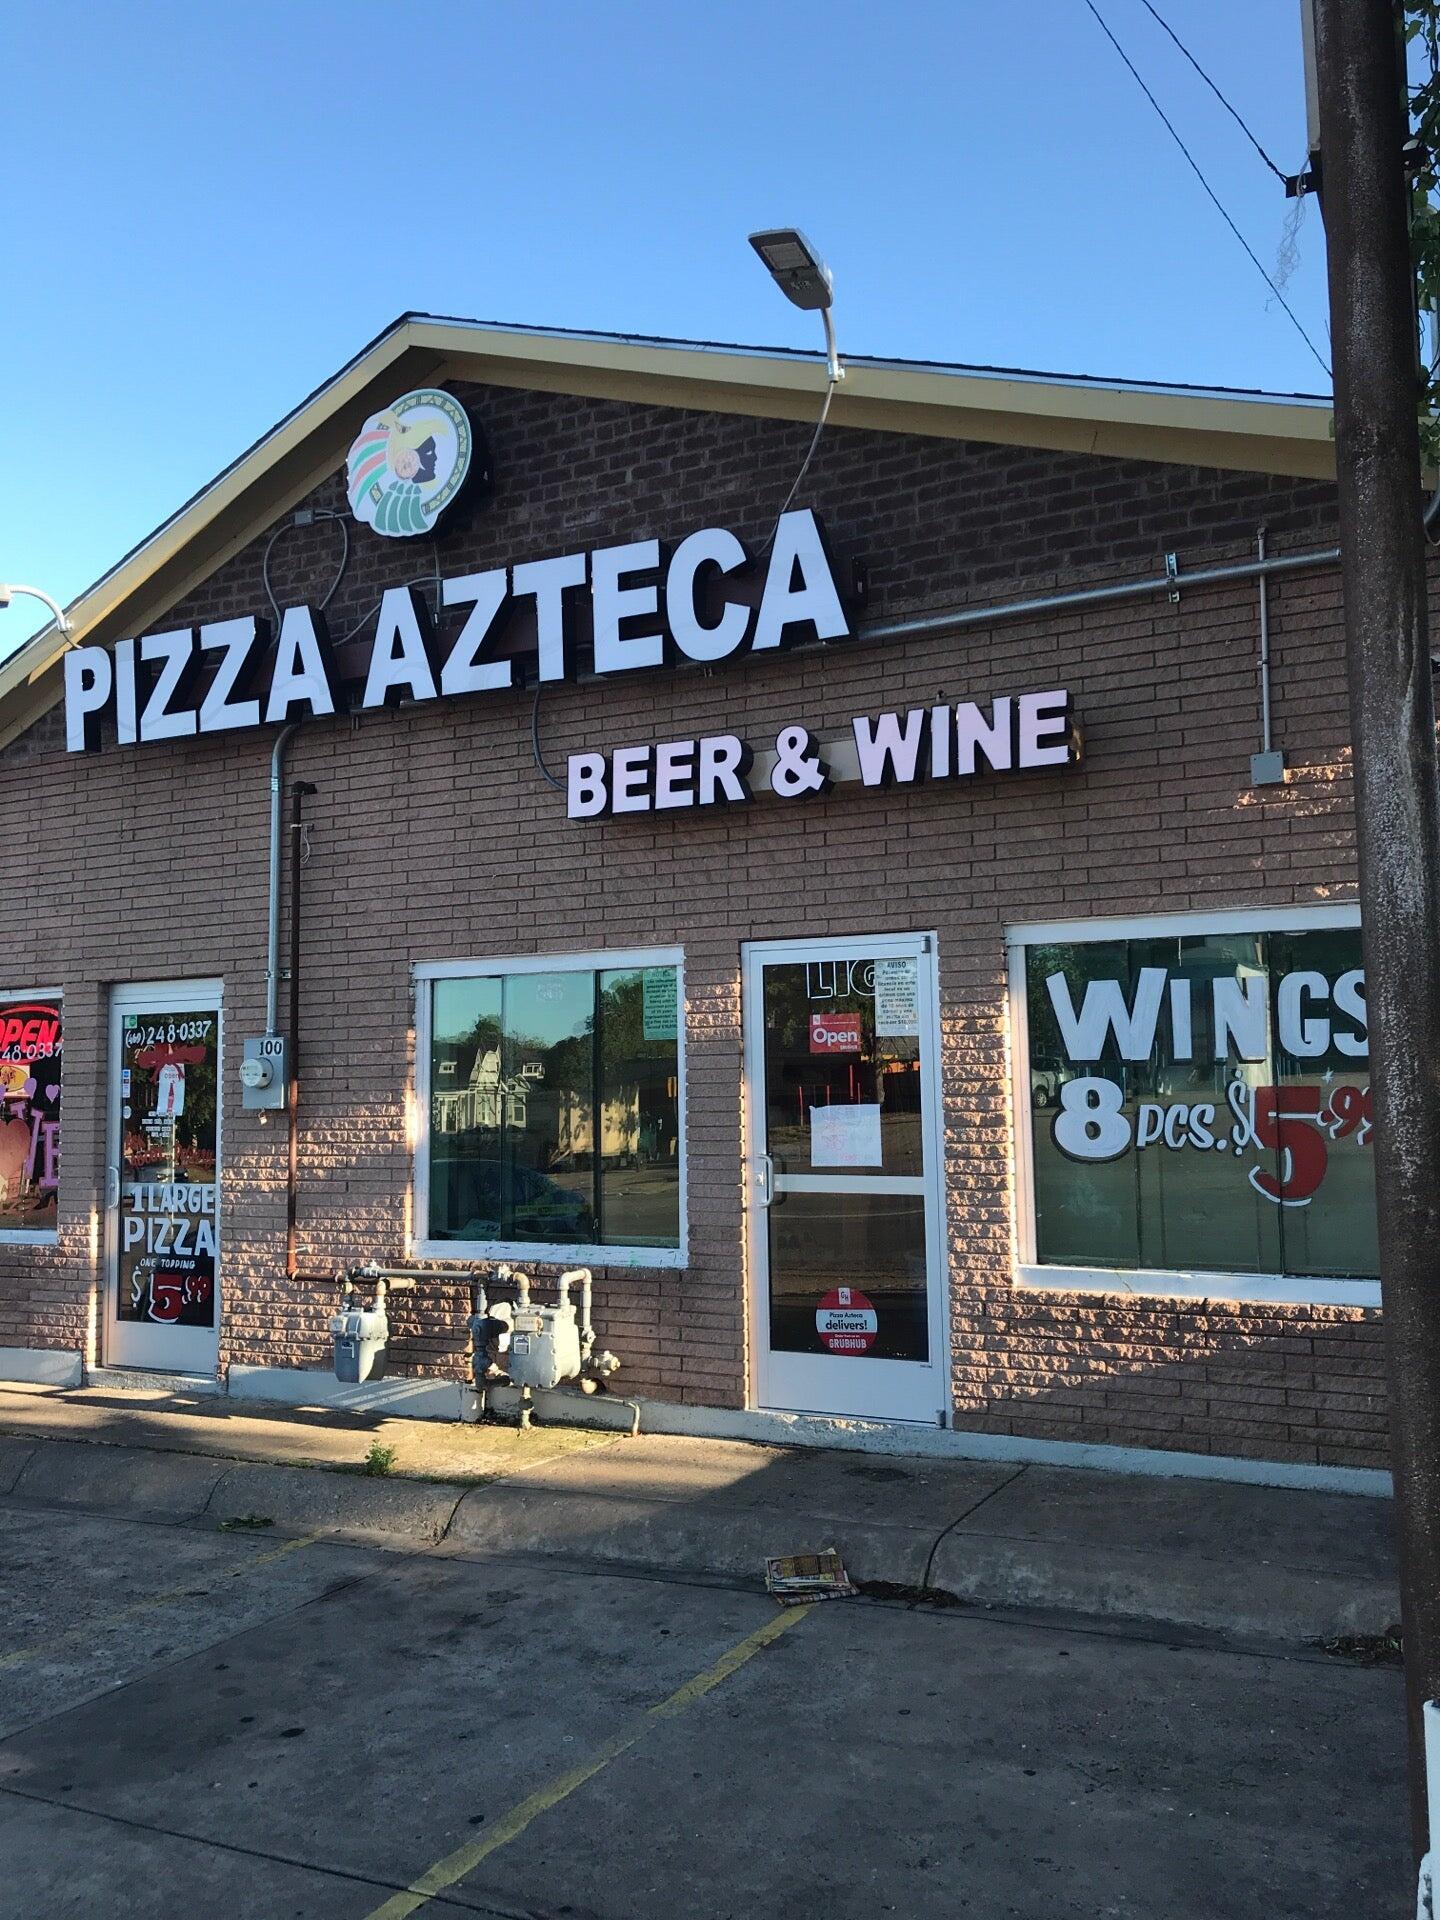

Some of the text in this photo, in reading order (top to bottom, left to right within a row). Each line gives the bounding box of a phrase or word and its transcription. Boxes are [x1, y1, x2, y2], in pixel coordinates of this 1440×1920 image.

[64, 508, 851, 752] PIZZA AZTECA
[567, 689, 1070, 820] BEER & WINE
[1046, 967, 1369, 1061] WINGS
[259, 1041, 282, 1056] 100
[813, 1027, 857, 1047] Open
[1054, 1077, 1132, 1158] 8
[131, 1185, 216, 1214] 1 LARGE
[124, 1216, 216, 1257] PIZZA
[140, 1257, 196, 1269] ONE TOPPING
[825, 1319, 868, 1330] delivers!
[829, 1338, 868, 1349] GRUBHUB
